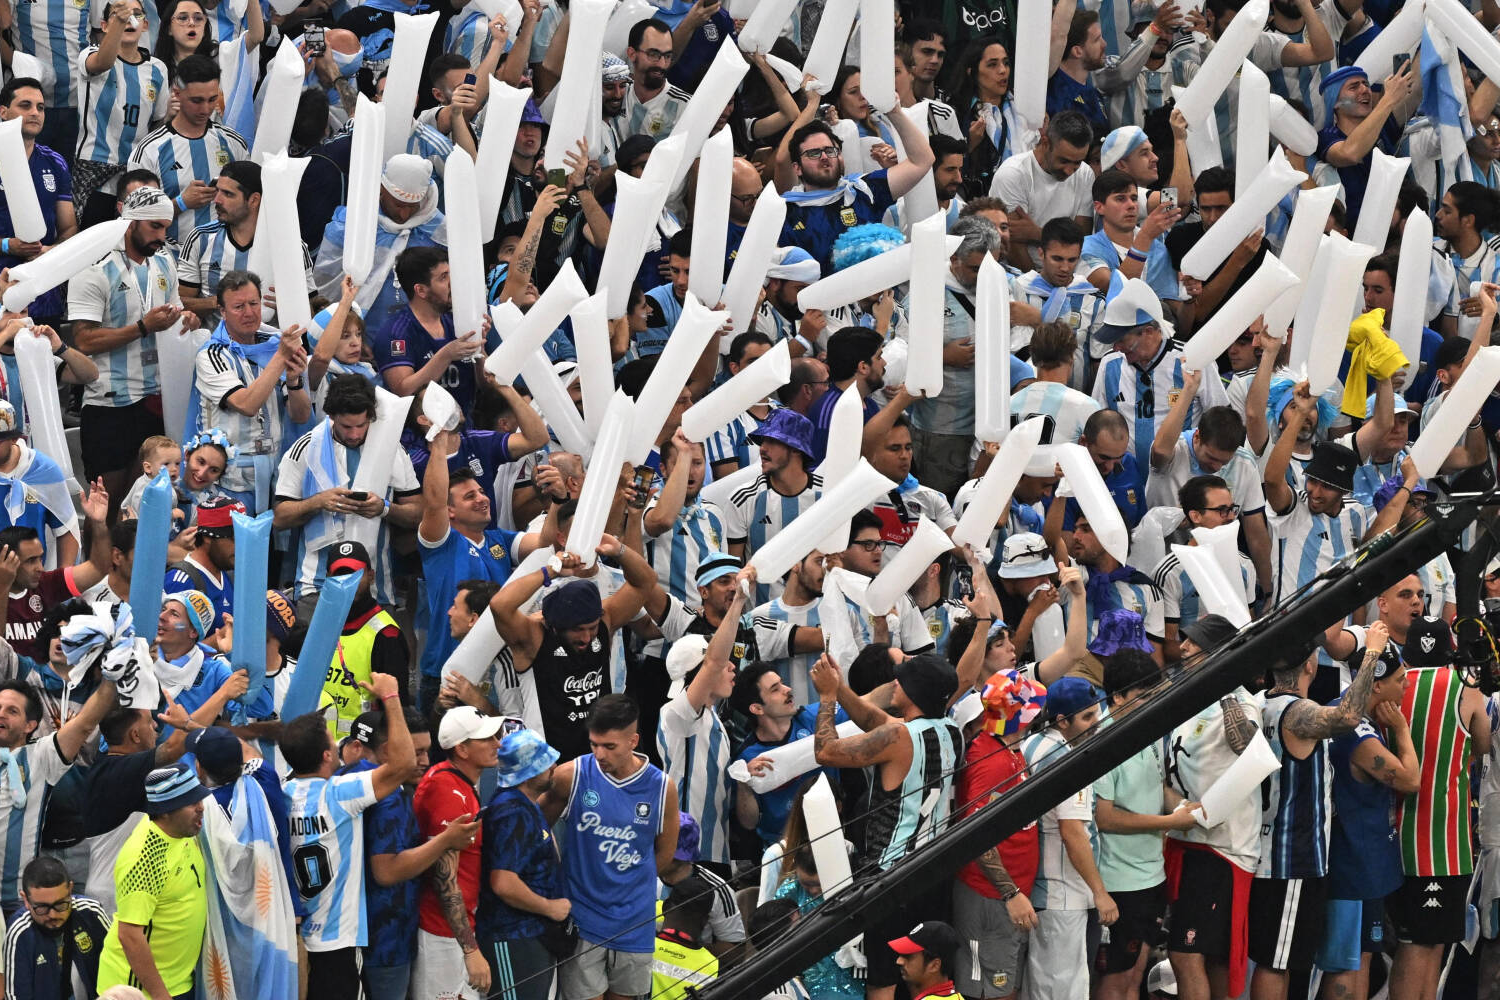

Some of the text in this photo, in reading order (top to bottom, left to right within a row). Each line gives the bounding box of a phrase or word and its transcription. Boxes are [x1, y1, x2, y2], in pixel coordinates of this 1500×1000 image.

[122, 103, 141, 127] 10
[287, 815, 329, 837] ADONA
[576, 811, 638, 842] Puerto
[599, 840, 641, 872] Viejo
